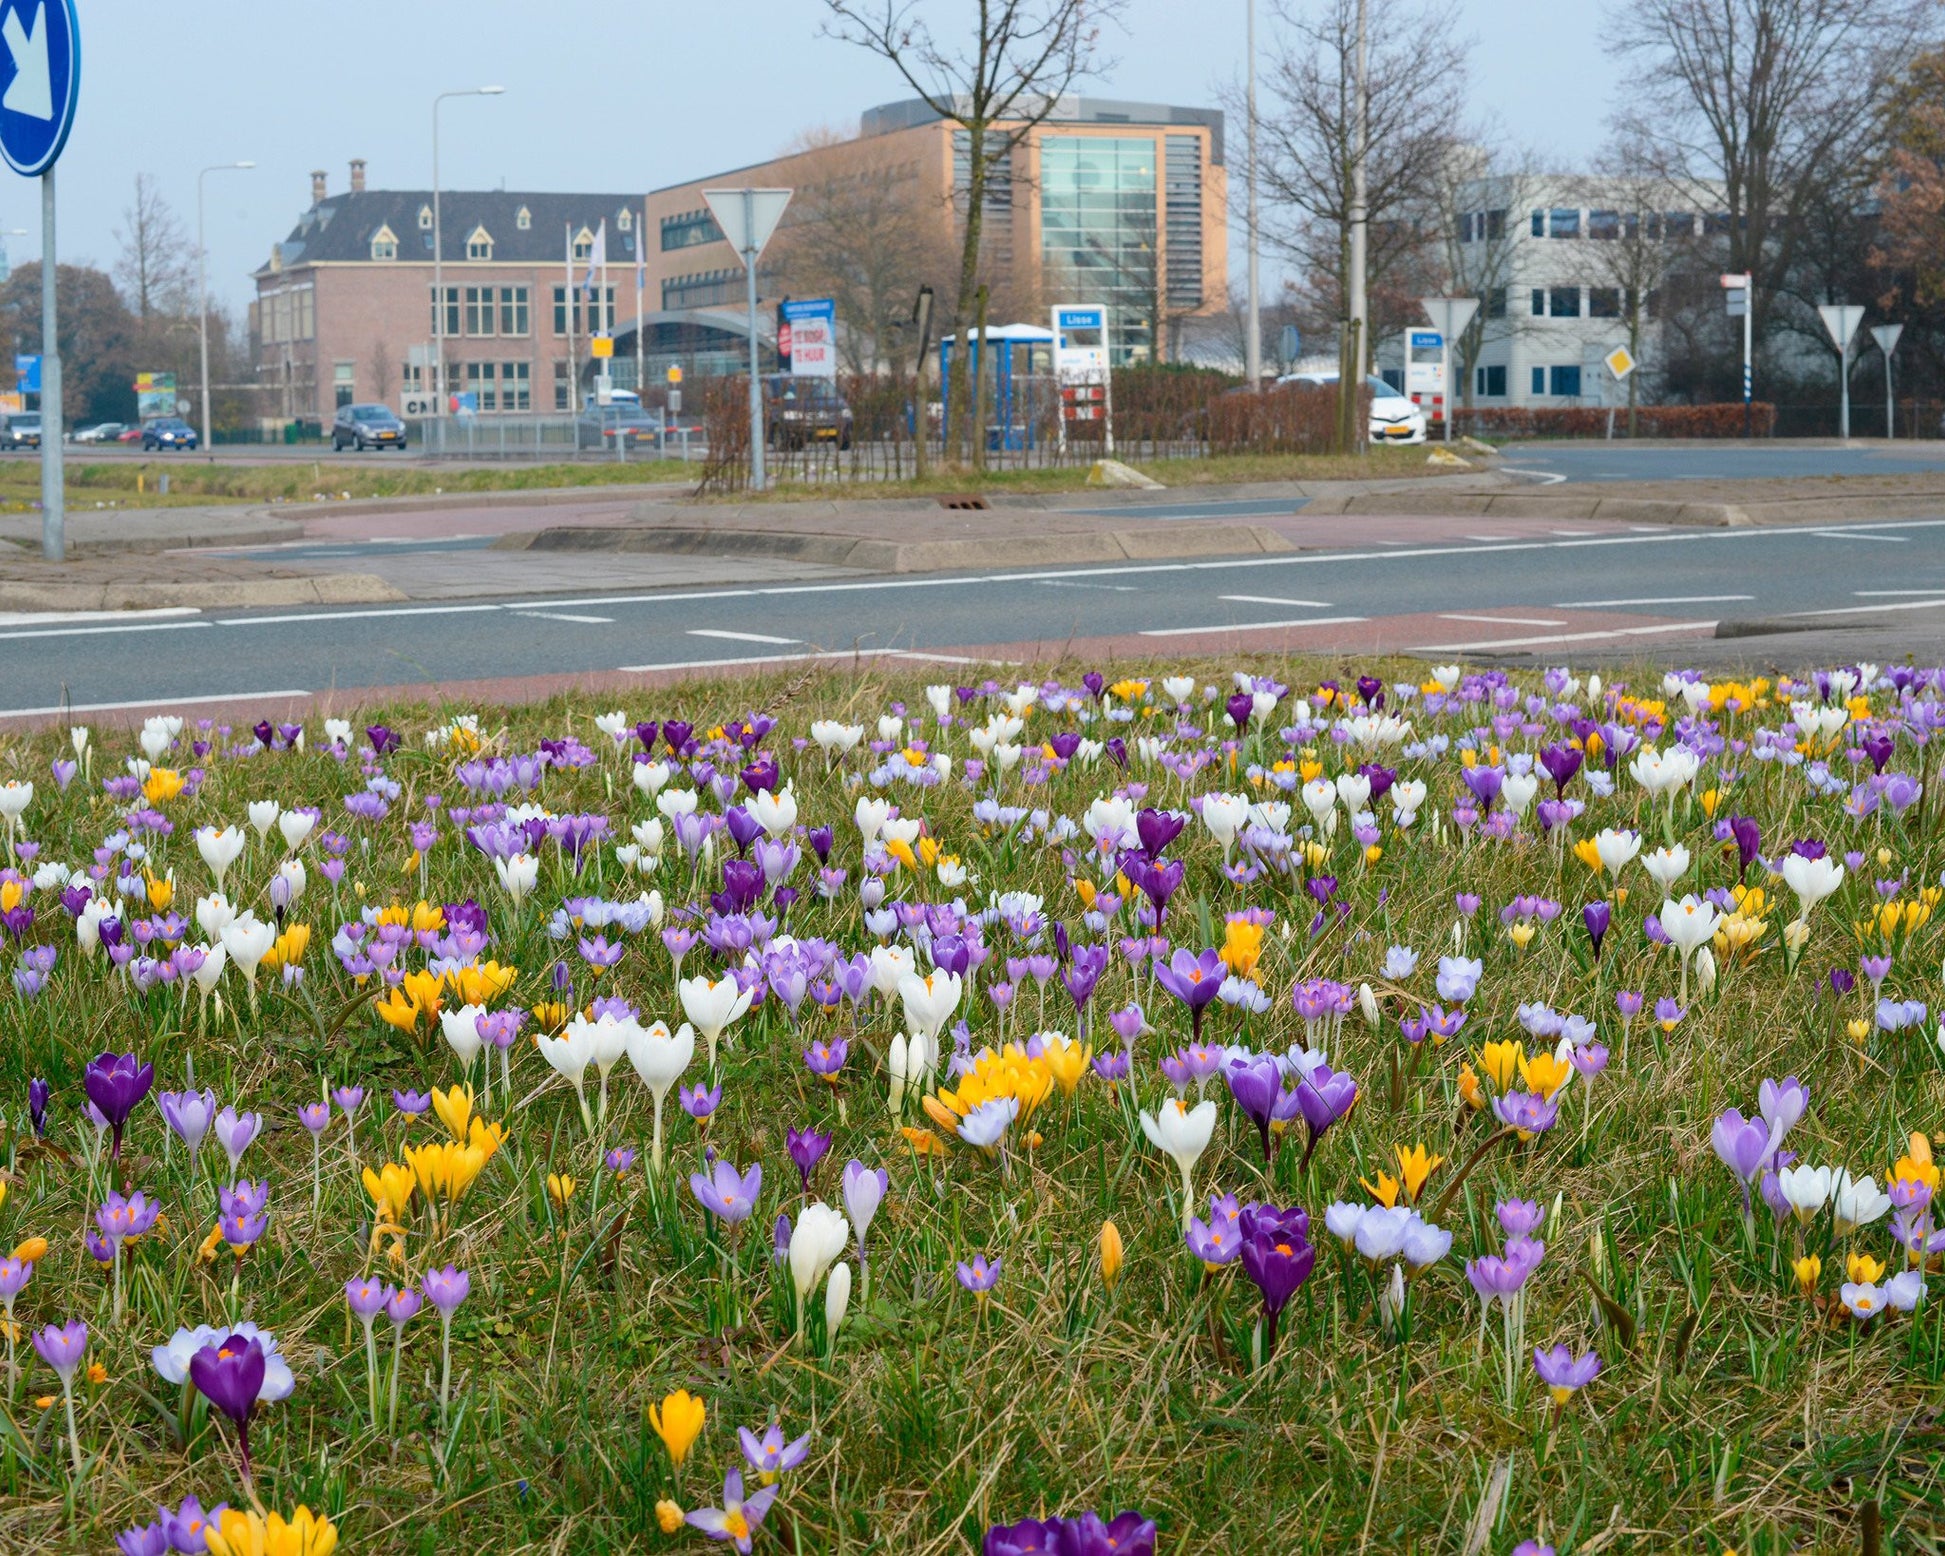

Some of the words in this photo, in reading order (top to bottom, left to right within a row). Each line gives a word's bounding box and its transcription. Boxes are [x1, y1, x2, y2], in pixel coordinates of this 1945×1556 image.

[1066, 314, 1092, 325] Lisse
[1417, 336, 1438, 345] Lisse
[795, 348, 803, 363] TE
[804, 347, 825, 362] HUUR
